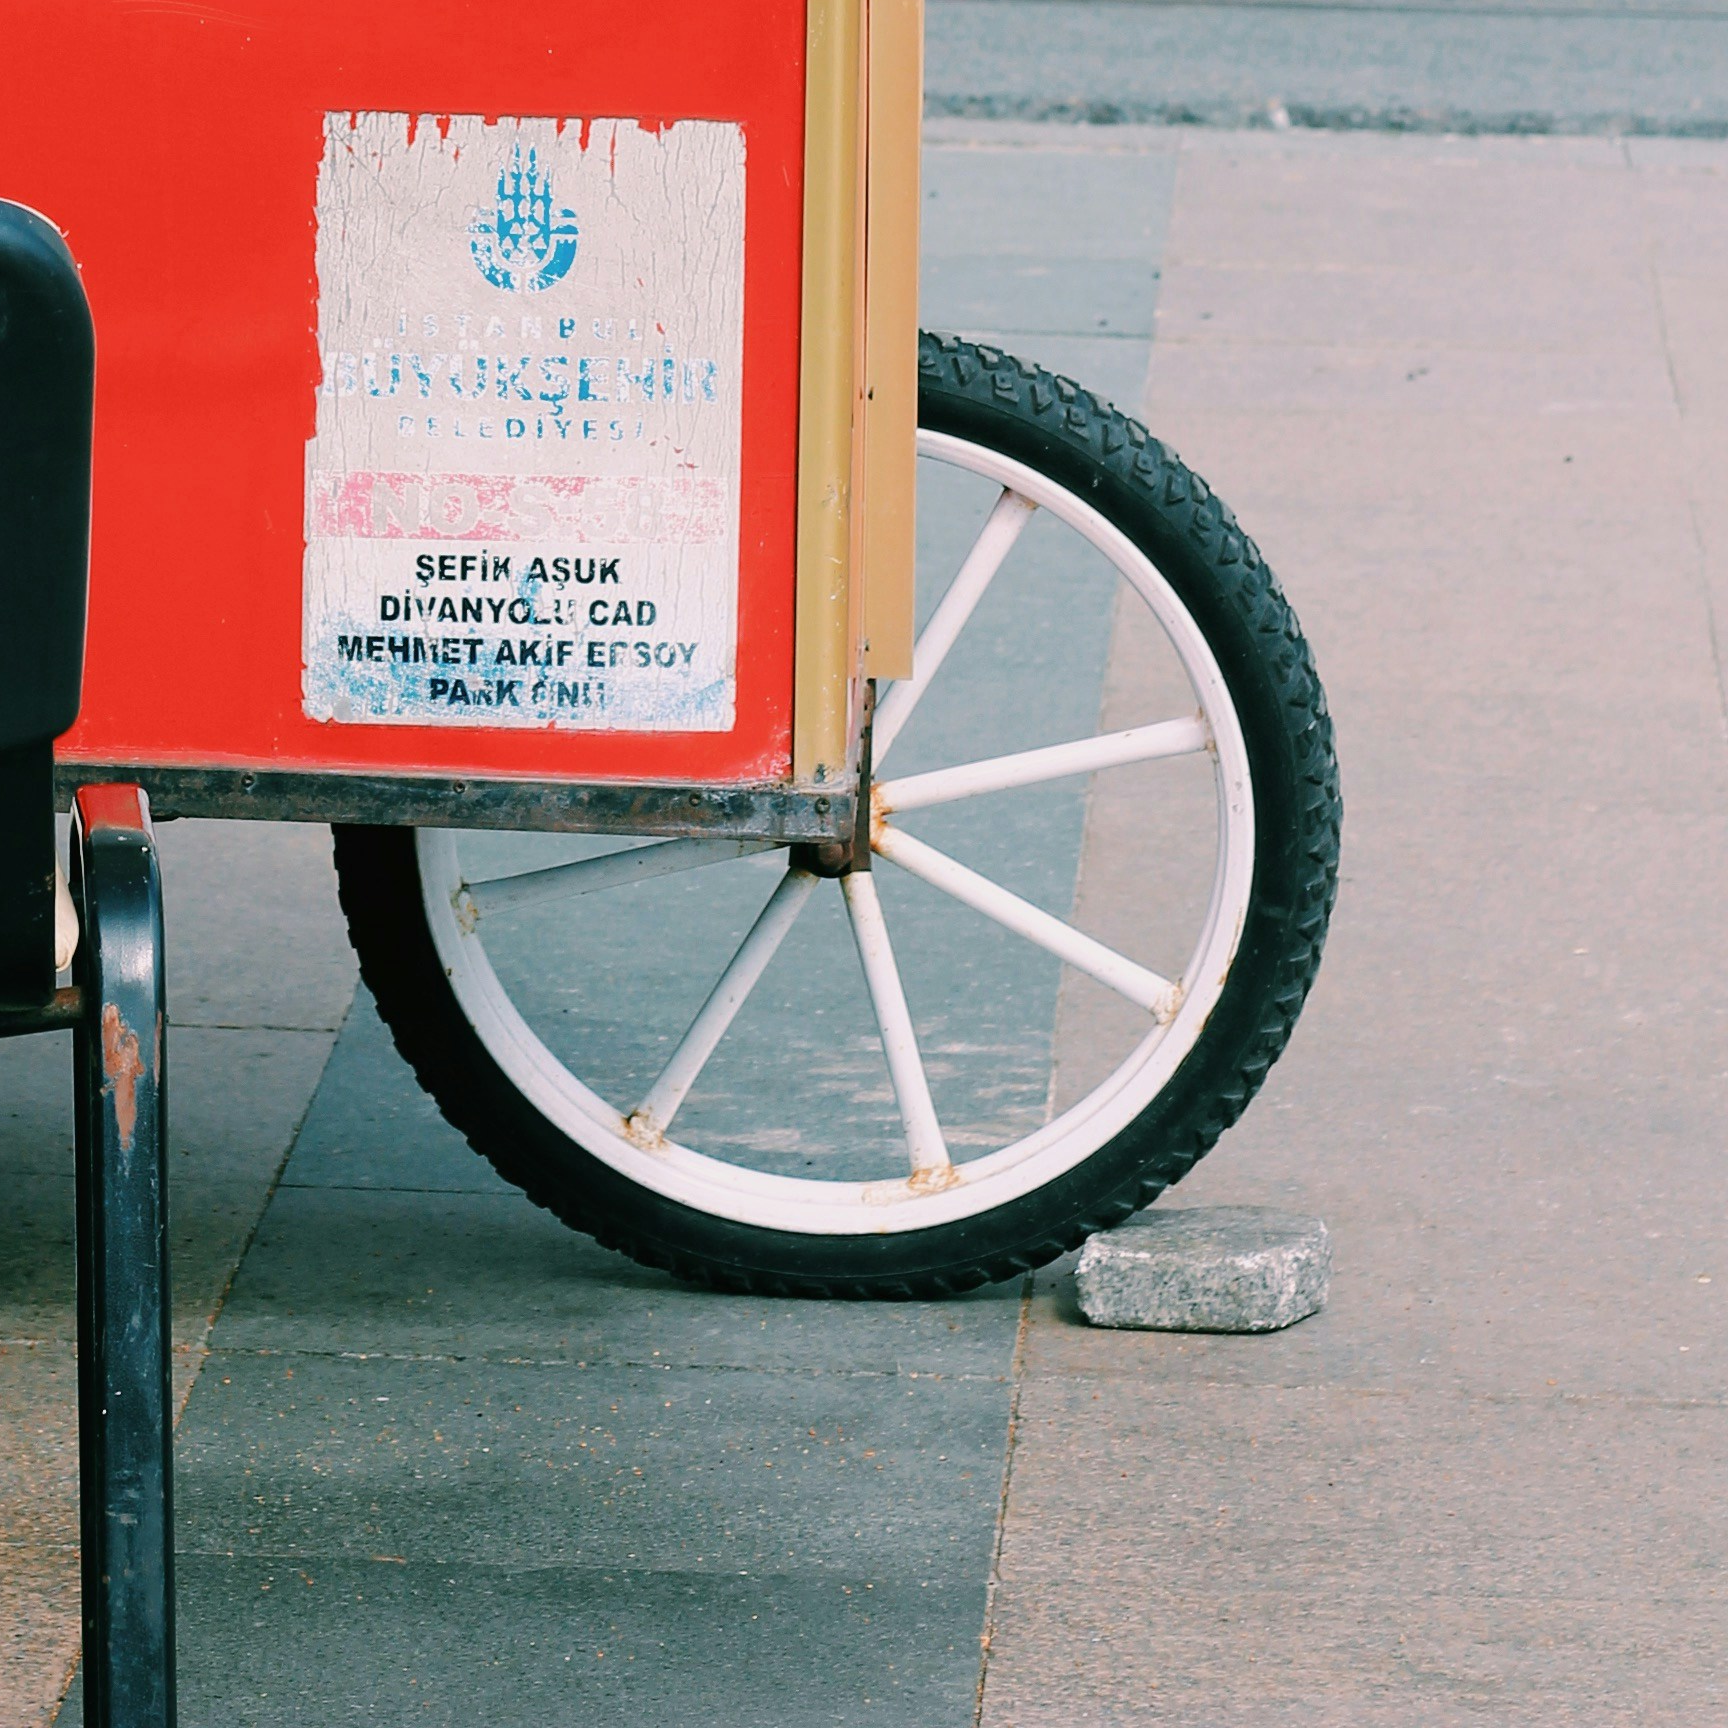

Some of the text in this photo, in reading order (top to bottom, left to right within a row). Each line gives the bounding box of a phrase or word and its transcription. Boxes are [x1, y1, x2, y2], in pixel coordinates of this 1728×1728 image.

[415, 548, 621, 591] ŞEFİK AŞUK
[588, 599, 657, 627] CAD
[338, 635, 484, 665] MEHMET
[494, 632, 576, 668] AKİF
[429, 678, 520, 707] PARK
